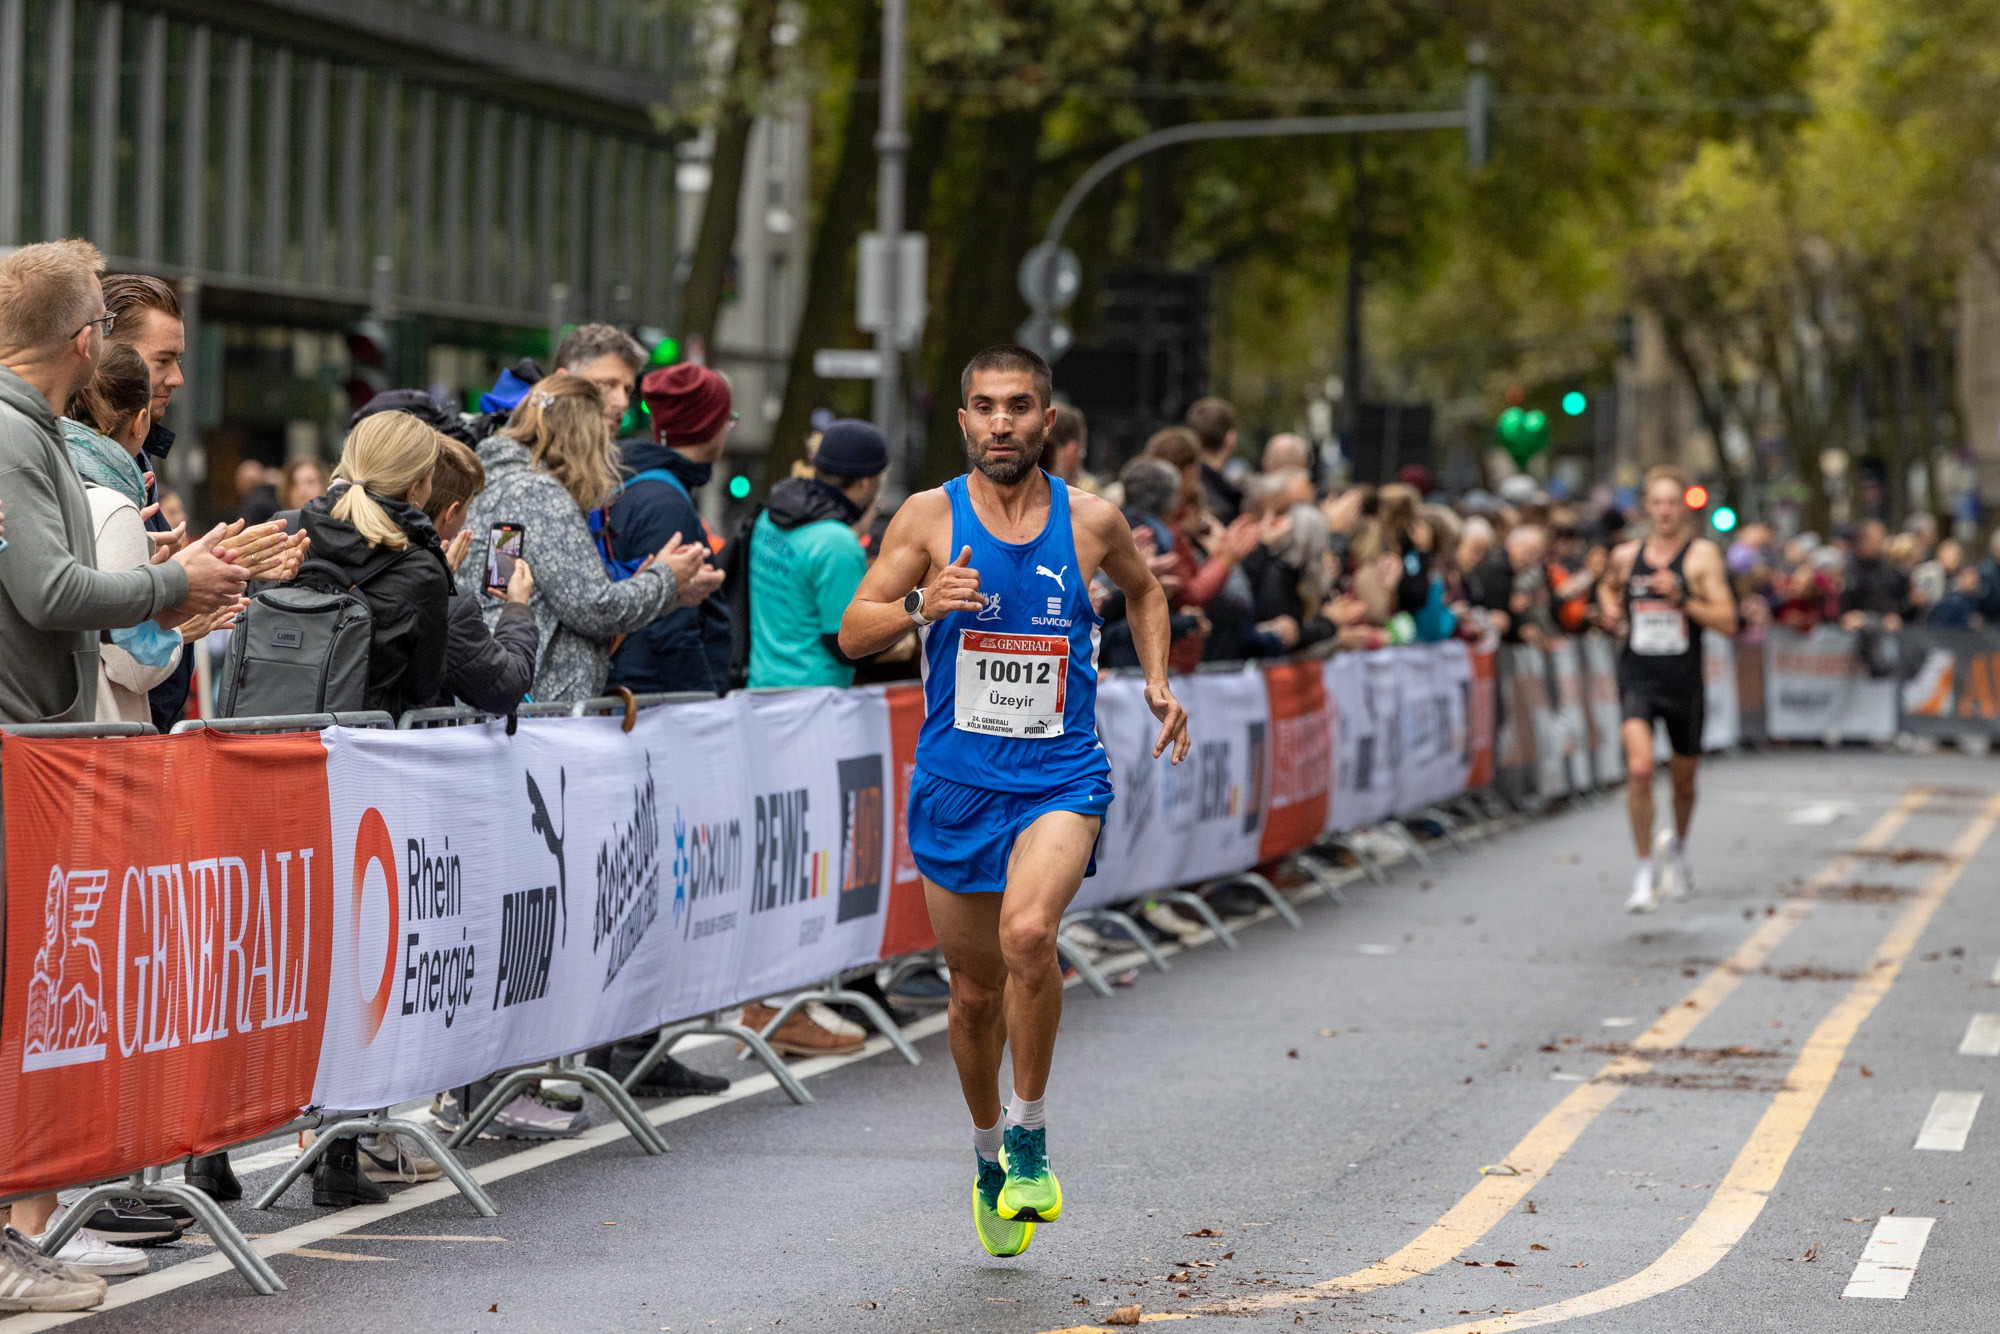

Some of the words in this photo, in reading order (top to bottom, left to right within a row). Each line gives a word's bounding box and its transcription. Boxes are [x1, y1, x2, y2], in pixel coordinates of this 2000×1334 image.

[1031, 616, 1072, 628] SUVICOM
[997, 639, 1052, 652] GENERALI
[976, 659, 1050, 684] 10012
[989, 690, 1034, 709] Üzeyir
[967, 721, 981, 730] KÖLN
[982, 724, 1013, 734] MARATHON
[972, 715, 981, 723] 24.
[981, 717, 1009, 726] GENERALI
[1024, 726, 1045, 734] PUMA
[750, 787, 808, 915] REWE
[407, 837, 461, 921] Rhein
[683, 817, 742, 942] pixum
[116, 847, 314, 1059] GENERALI
[492, 885, 557, 1012] PUMA
[401, 926, 475, 1028] Energie
